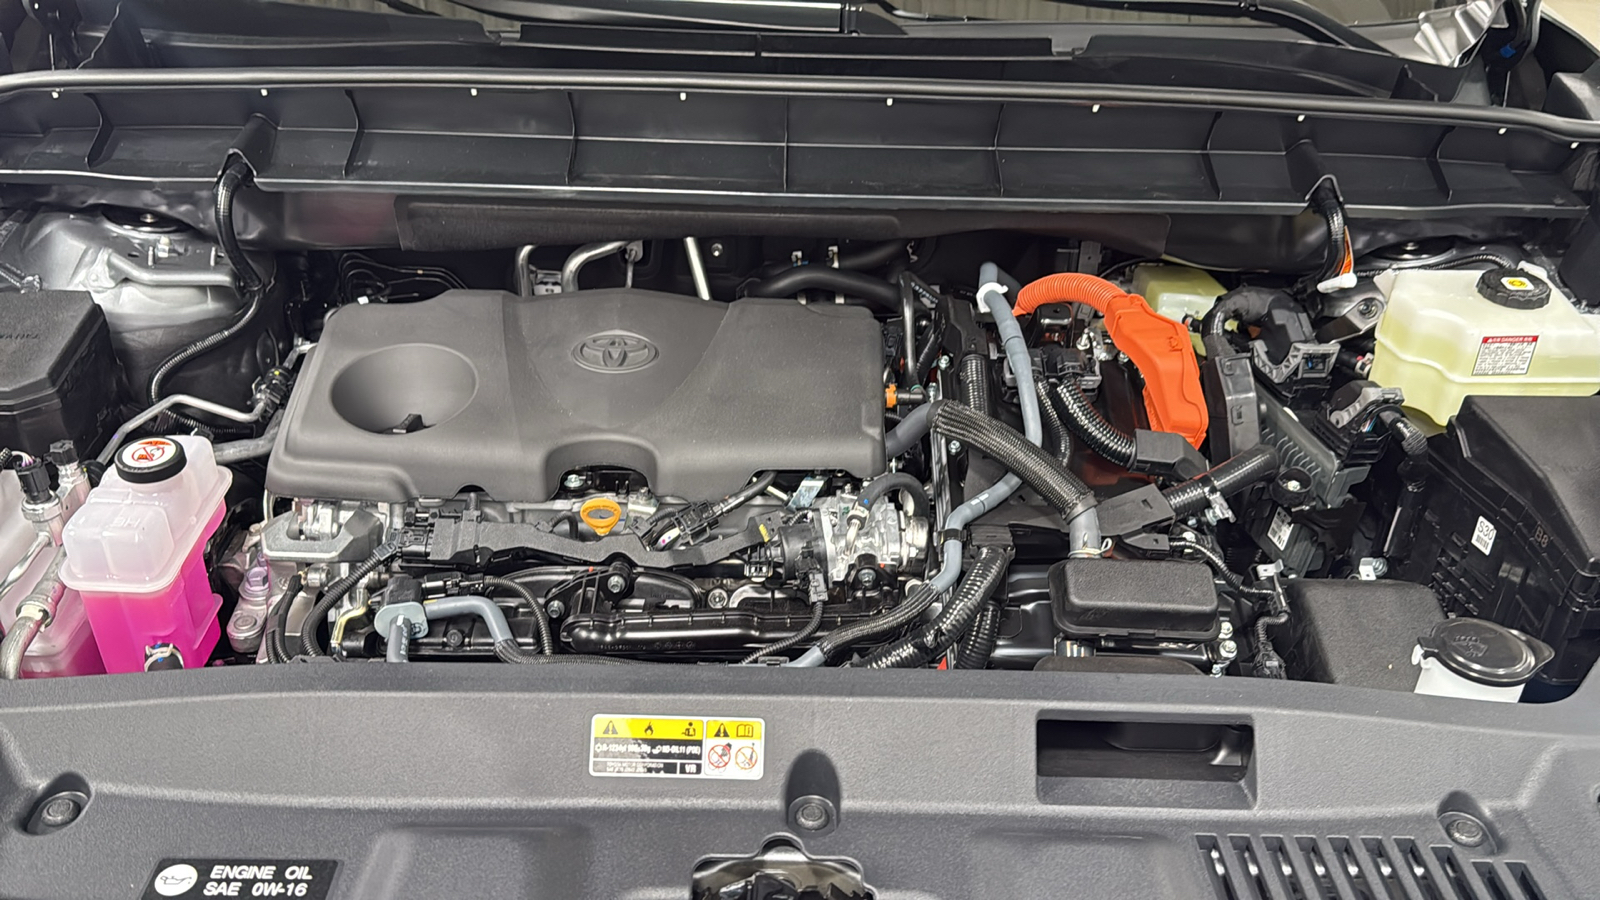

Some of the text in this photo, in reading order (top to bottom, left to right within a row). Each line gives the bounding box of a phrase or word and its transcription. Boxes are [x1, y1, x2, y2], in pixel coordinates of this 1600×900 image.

[1478, 521, 1494, 541] S30
[684, 763, 697, 774] VR
[210, 865, 313, 880] ENGINE OIL
[203, 882, 308, 897] SAE 0W-16
